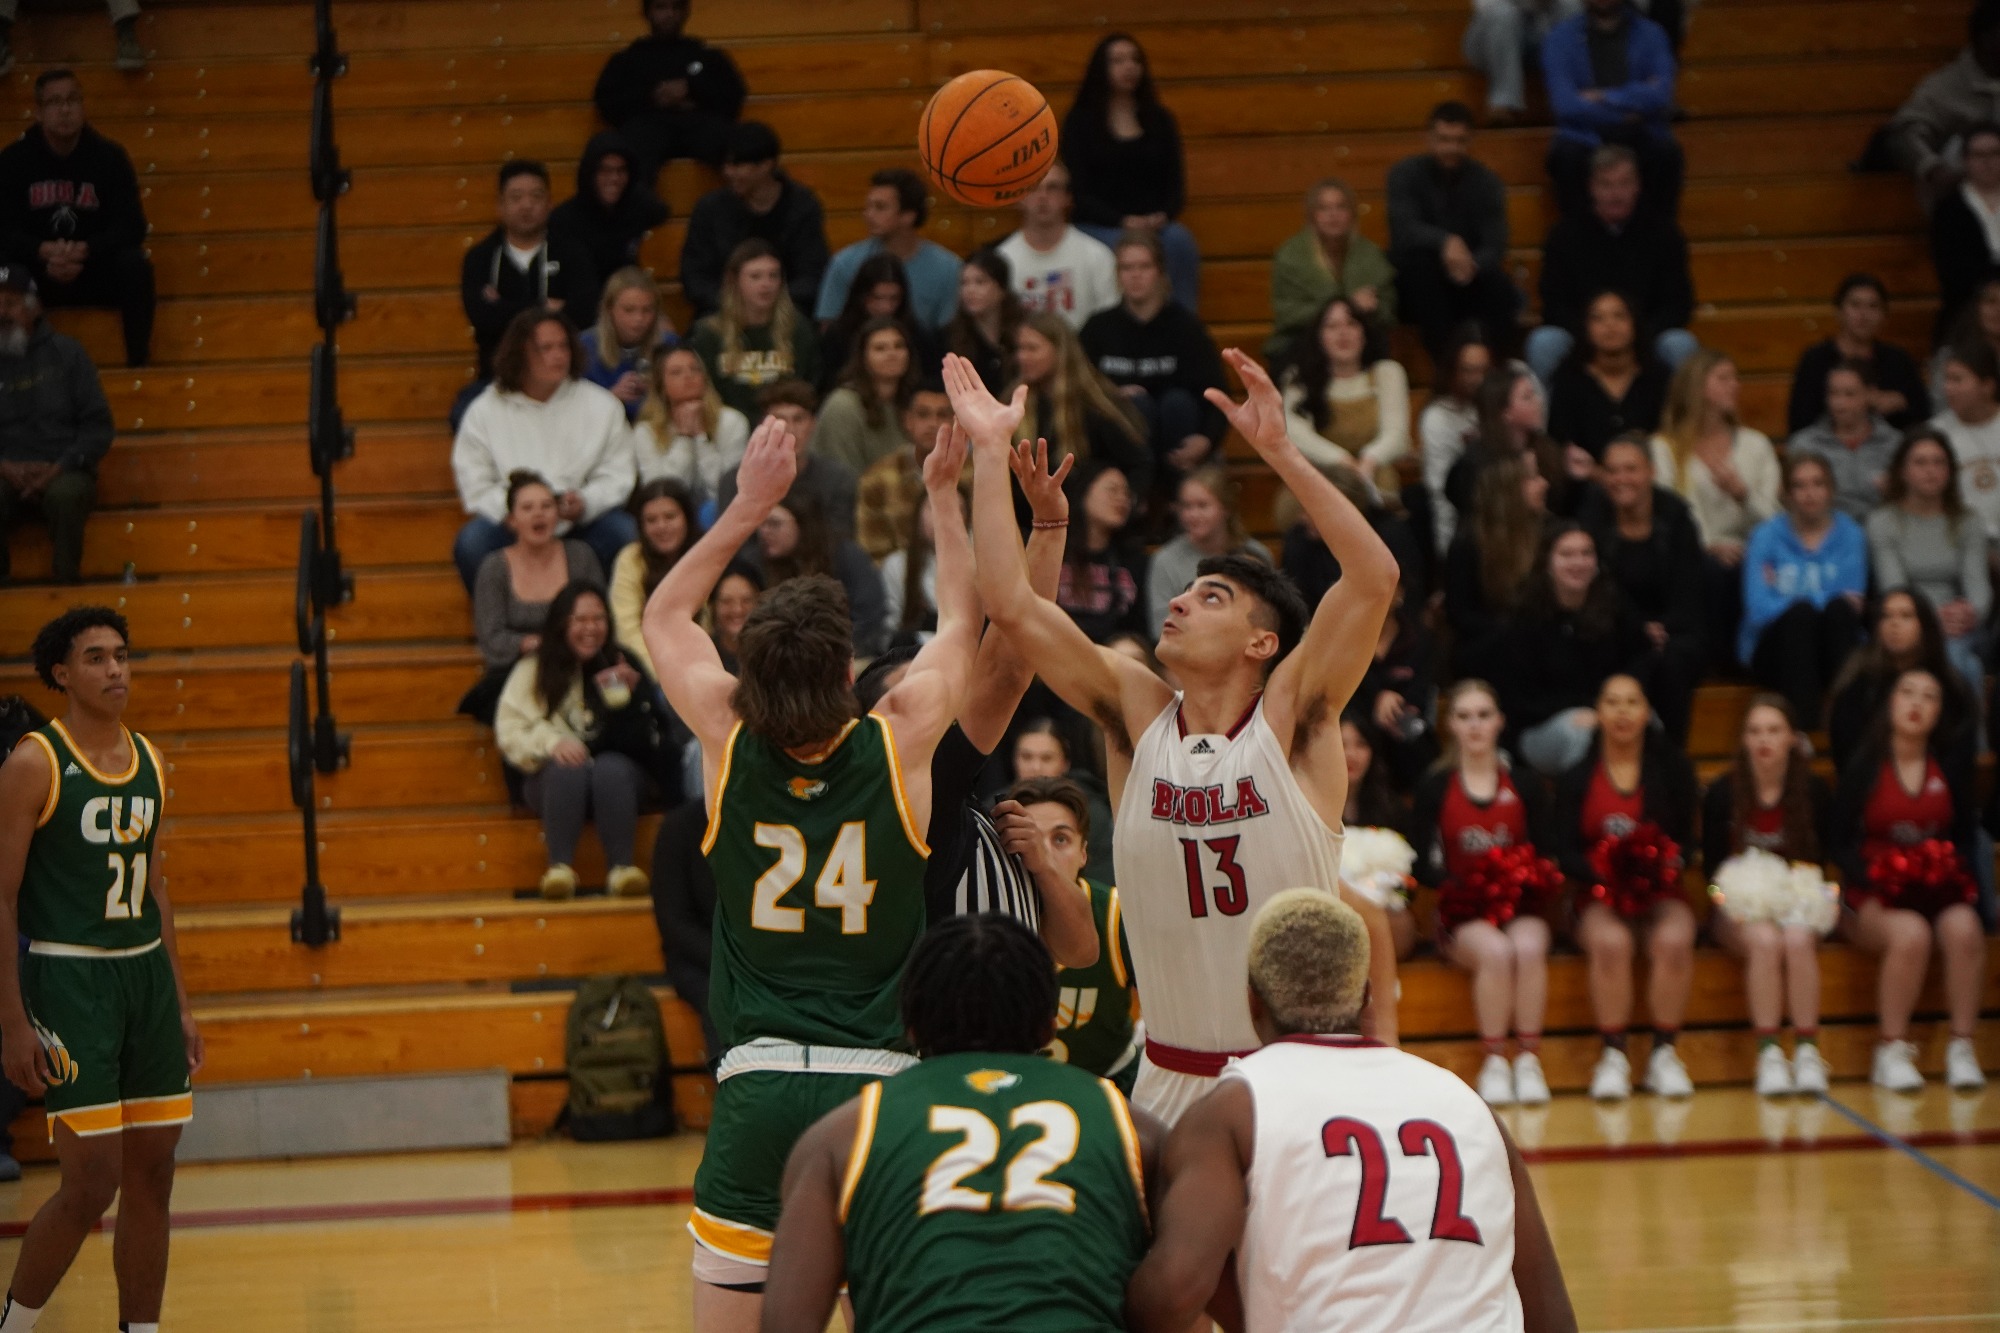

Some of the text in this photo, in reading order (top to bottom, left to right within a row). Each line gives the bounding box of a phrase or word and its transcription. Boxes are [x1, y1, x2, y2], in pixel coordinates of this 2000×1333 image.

[1151, 775, 1270, 826] BIOLA
[104, 853, 148, 919] 21
[752, 820, 878, 934] 24
[1178, 833, 1249, 918] 13
[918, 1099, 1081, 1217] 22
[1321, 1115, 1485, 1251] 22
